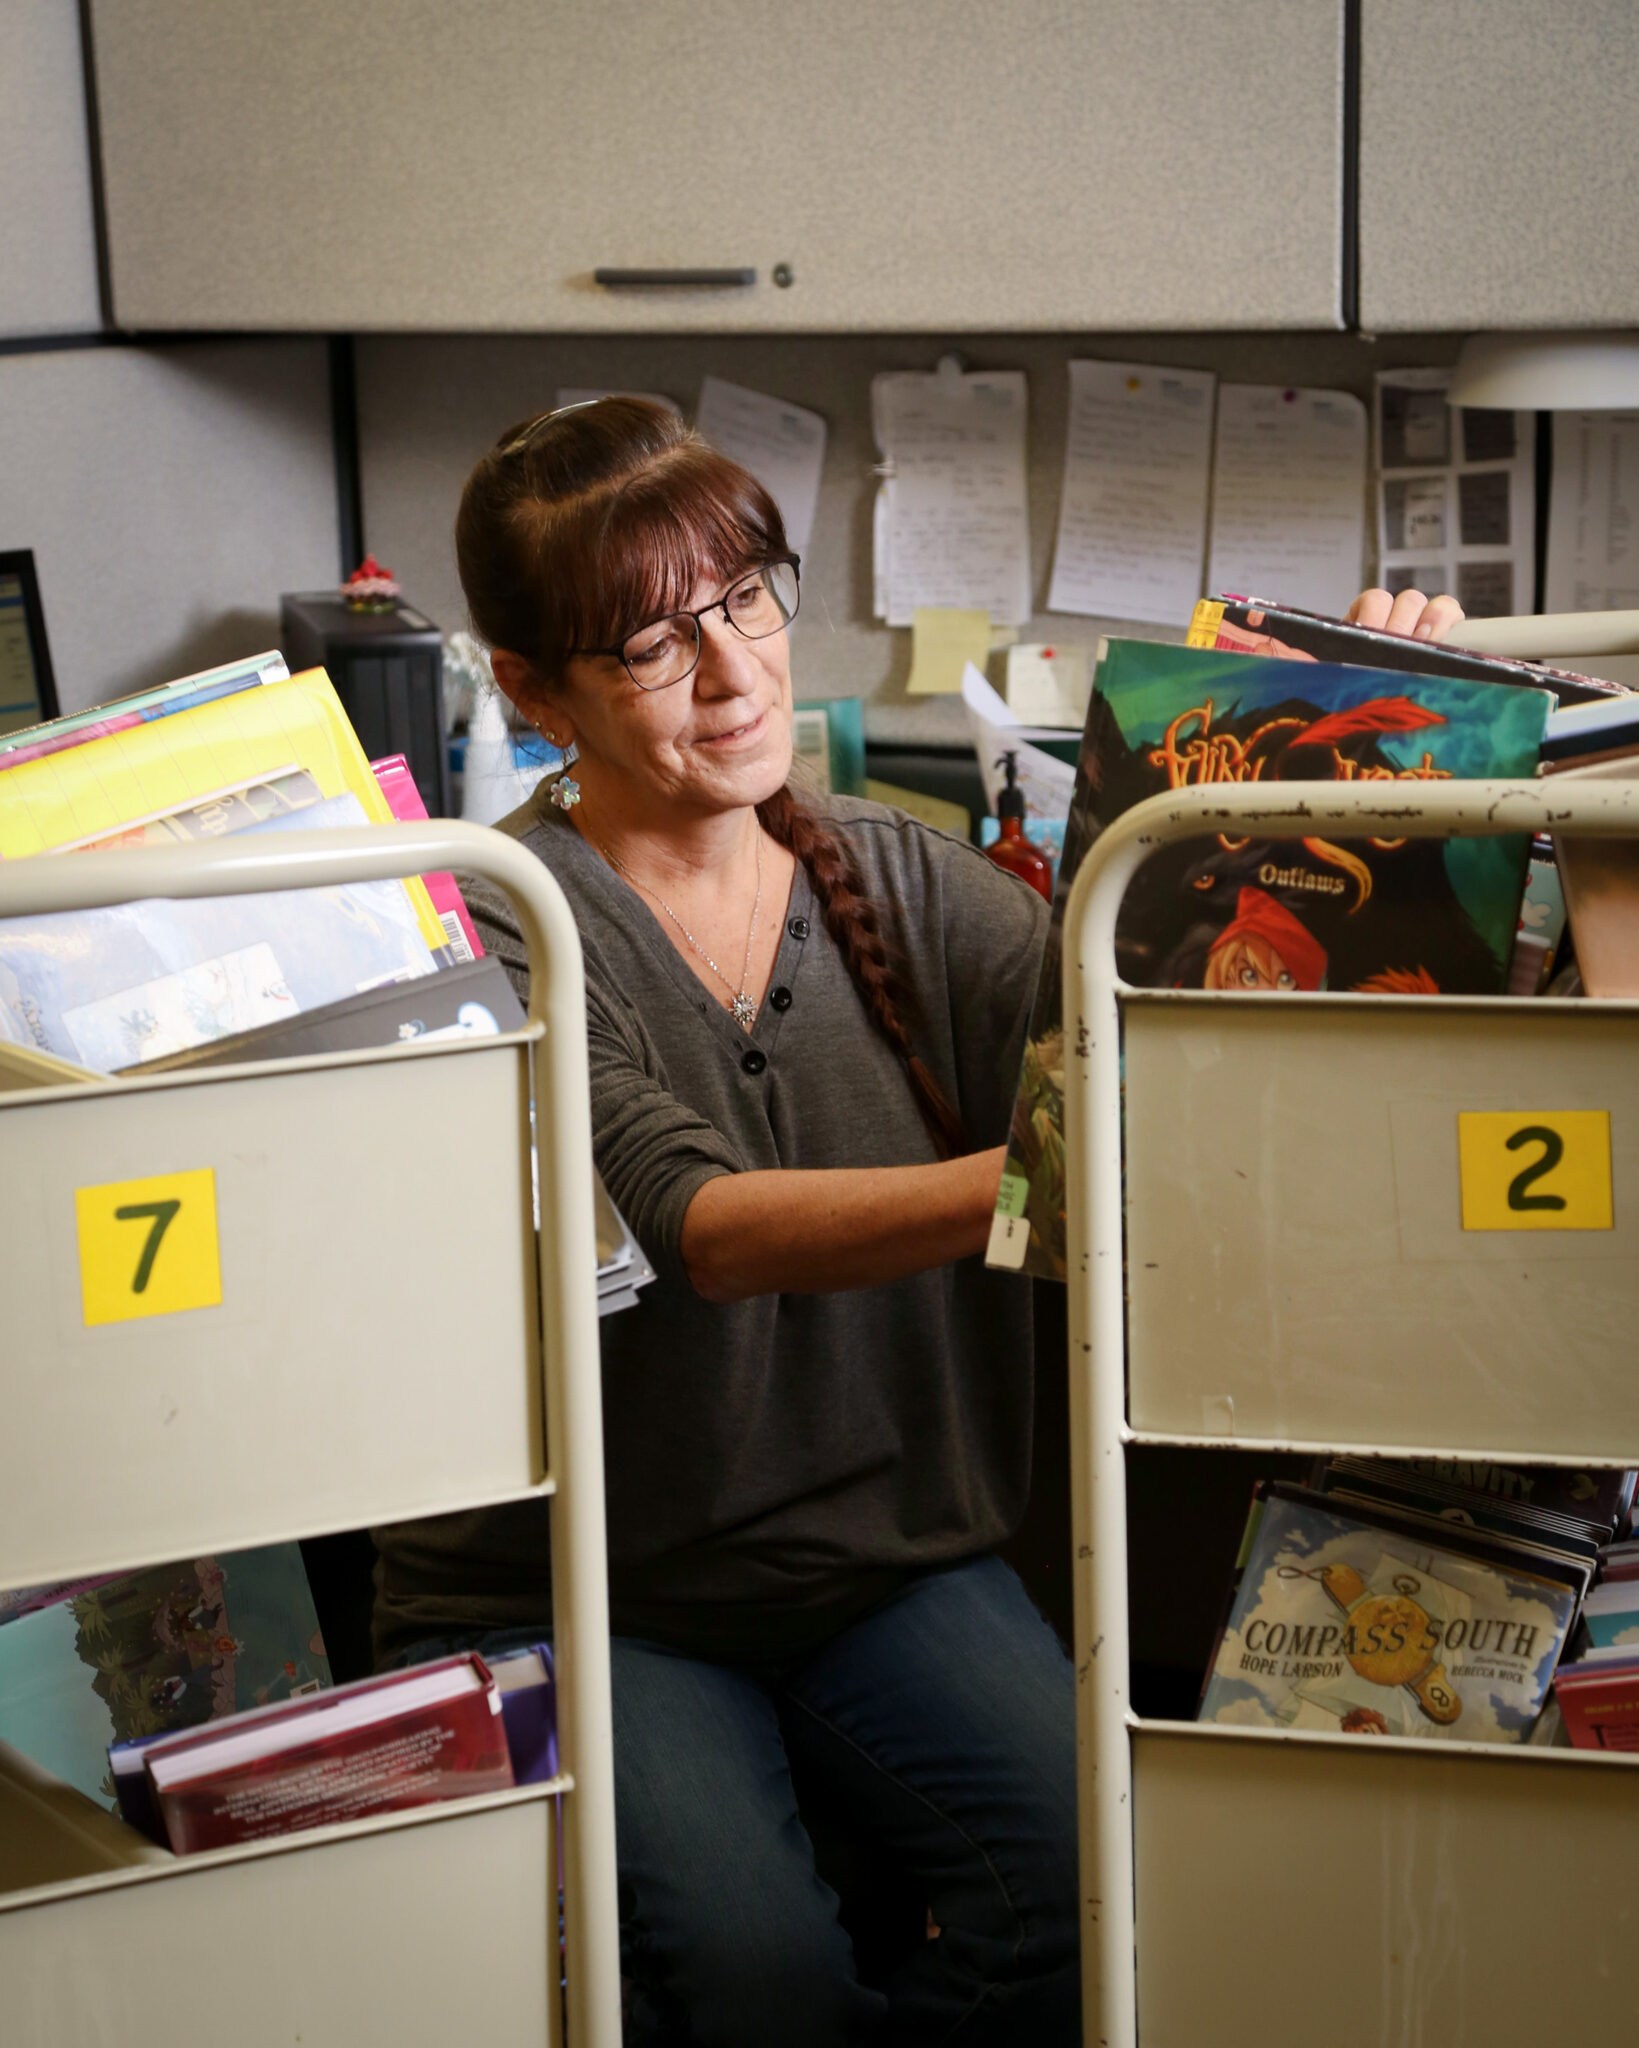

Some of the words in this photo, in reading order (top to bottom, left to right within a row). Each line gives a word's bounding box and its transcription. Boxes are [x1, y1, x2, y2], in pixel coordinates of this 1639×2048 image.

[1259, 863, 1346, 896] Outlaws
[1505, 1125, 1567, 1211] 2
[114, 1199, 181, 1294] 7
[1245, 1618, 1410, 1658] COMPASS
[1419, 1617, 1540, 1659] SOUTH
[1239, 1653, 1278, 1676] HOPE
[1281, 1660, 1345, 1679] LARSON
[1451, 1665, 1495, 1679] REBECCA
[1498, 1669, 1524, 1684] MOCK
